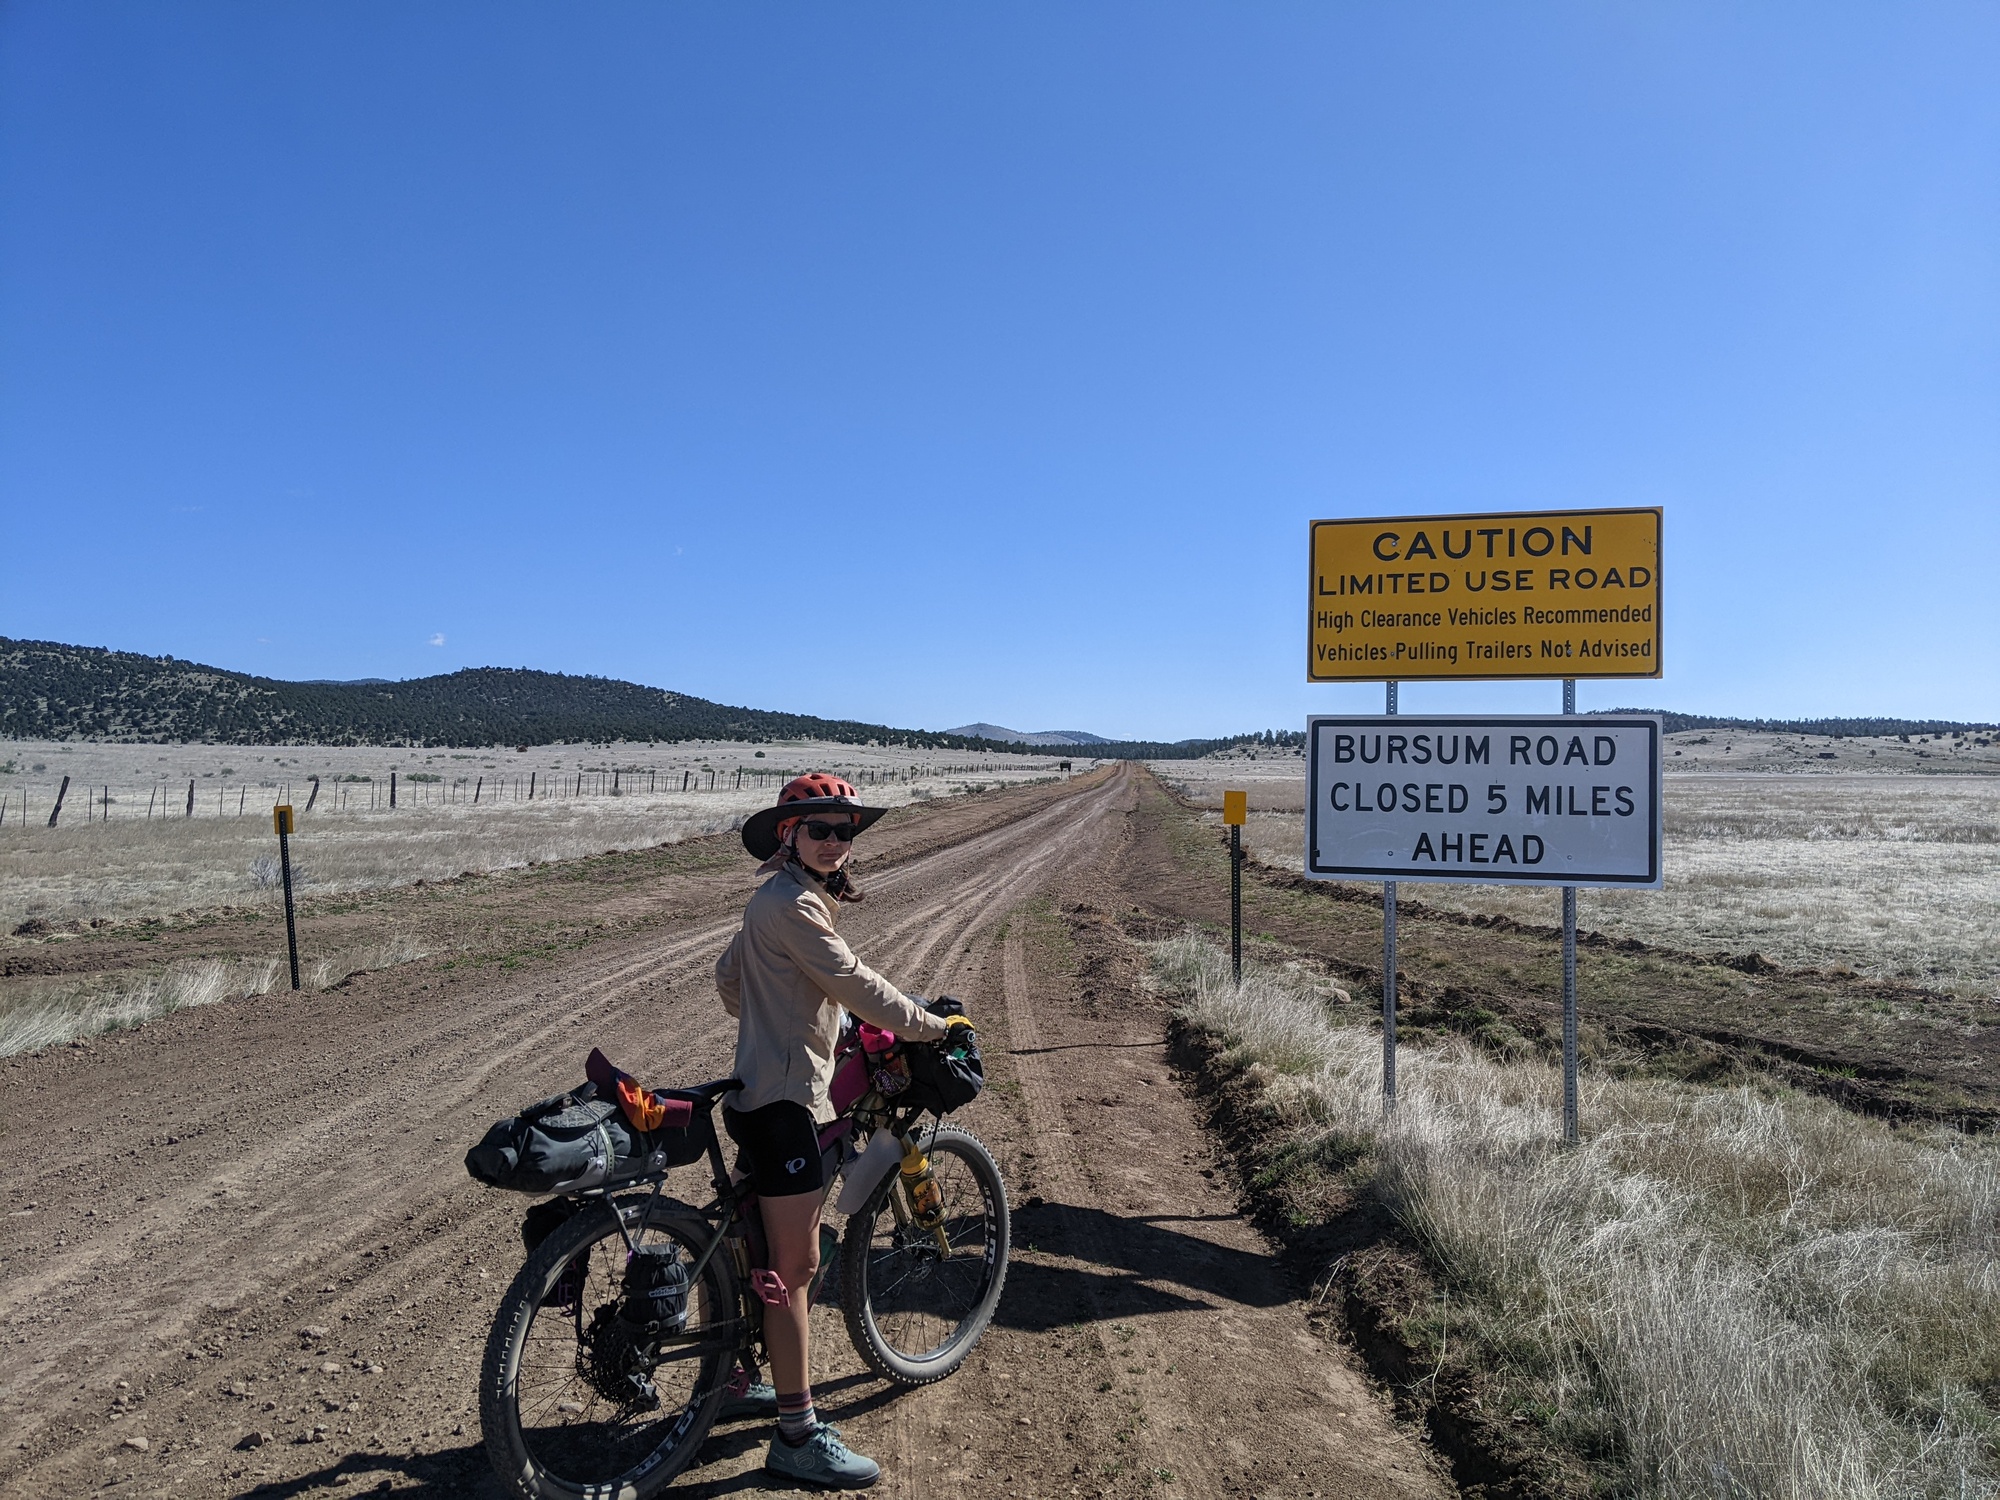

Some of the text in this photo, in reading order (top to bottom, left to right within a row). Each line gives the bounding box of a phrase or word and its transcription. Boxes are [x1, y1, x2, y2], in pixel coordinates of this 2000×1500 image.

[1372, 525, 1592, 562] CAUTION
[1318, 566, 1651, 596] LIMITED USE ROAD
[1317, 603, 1652, 634] High Clearance Vehicles Recommended
[1316, 638, 1651, 665] Vehicles Pulling Trailers Not Advised
[1334, 734, 1616, 766] BURSUM ROAD
[1330, 782, 1635, 817] CLOSED 5 MILES
[1411, 832, 1545, 865] AHEAD
